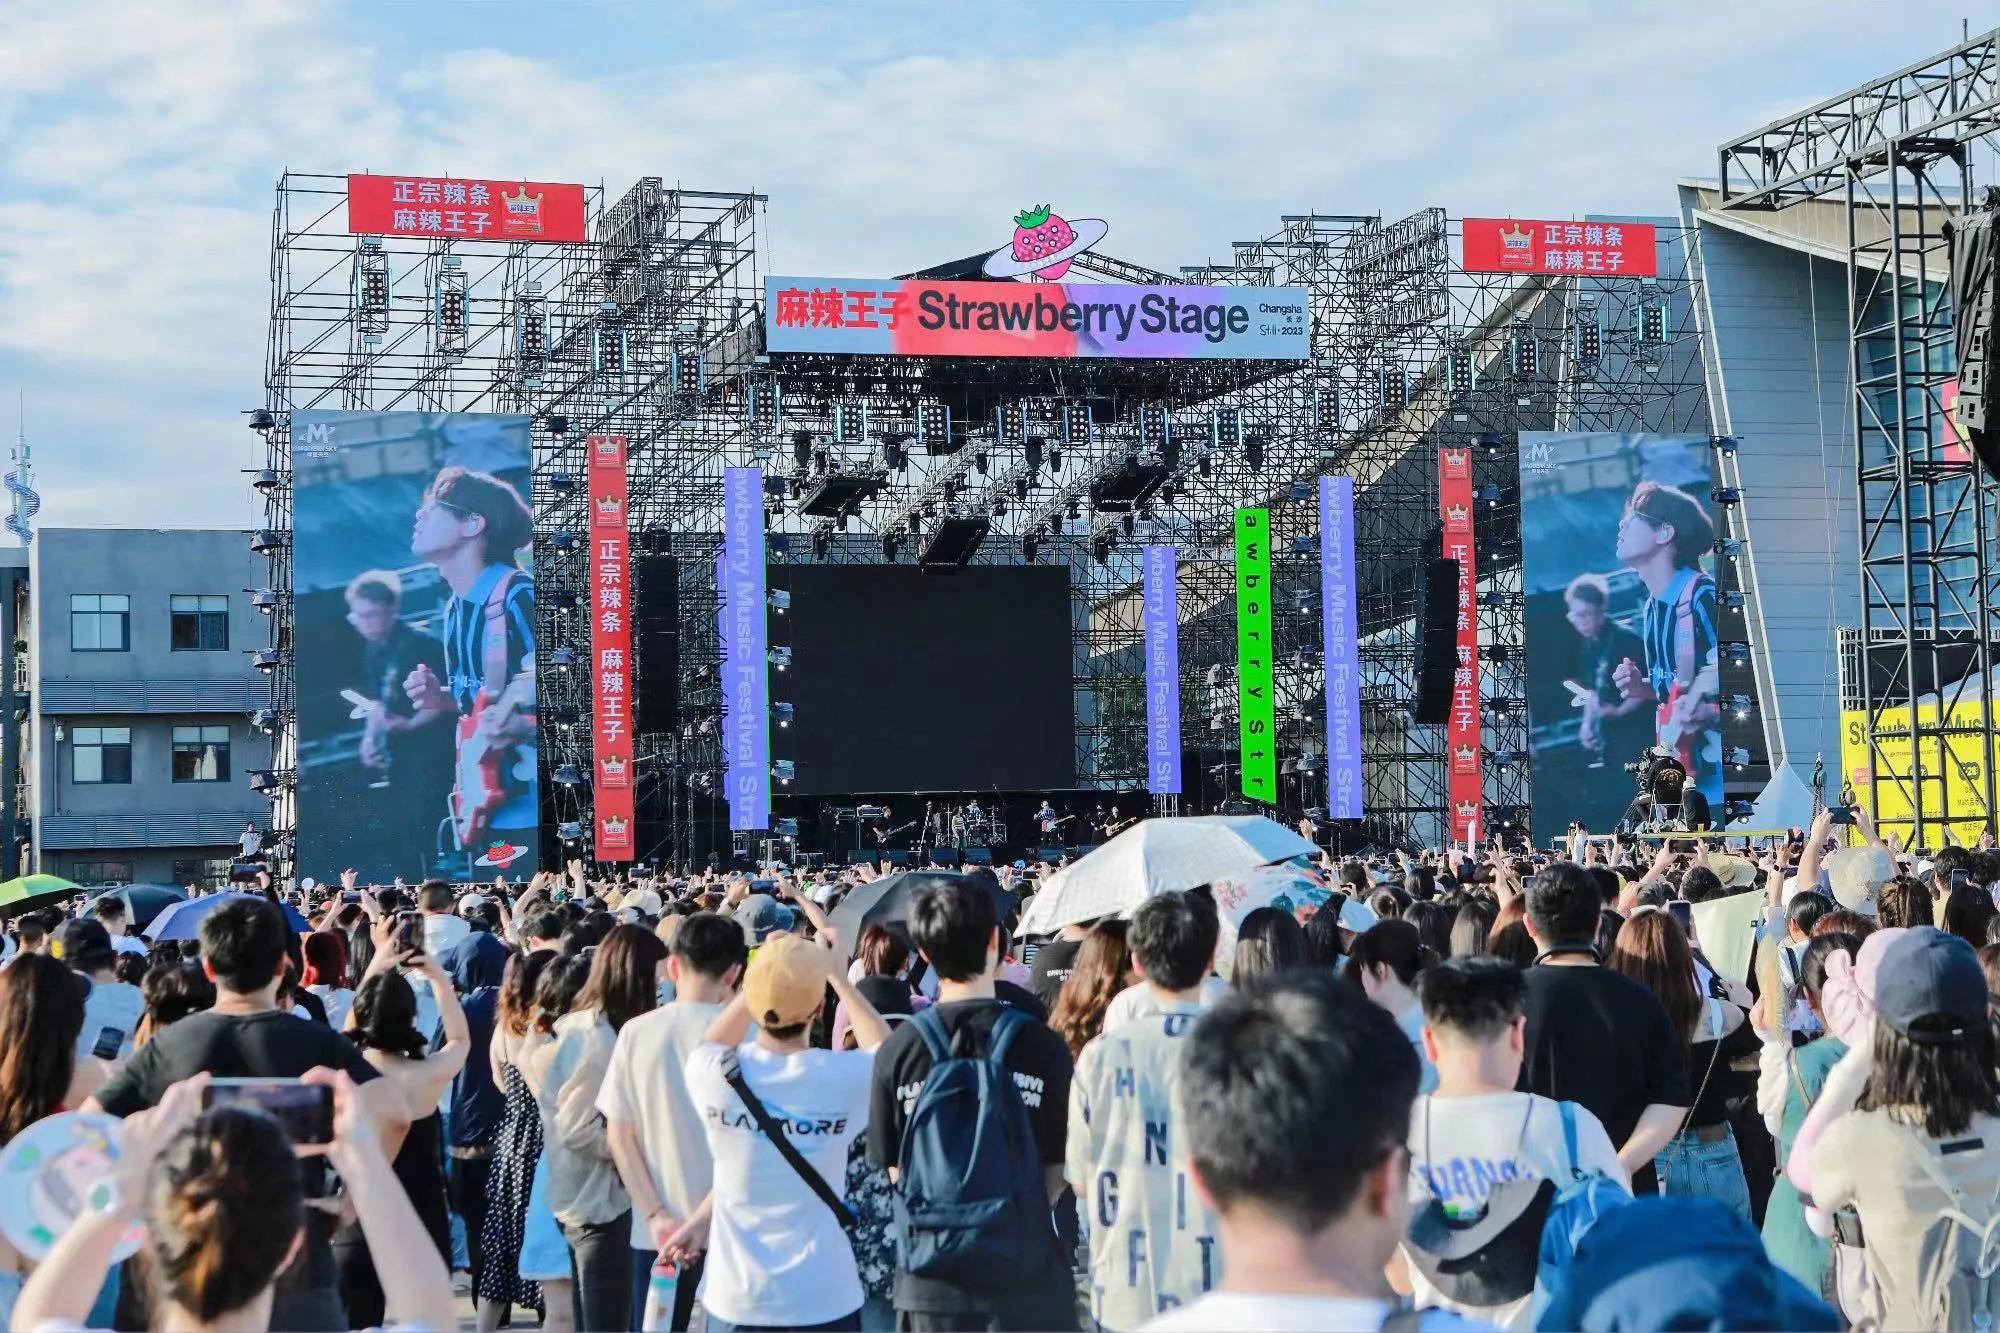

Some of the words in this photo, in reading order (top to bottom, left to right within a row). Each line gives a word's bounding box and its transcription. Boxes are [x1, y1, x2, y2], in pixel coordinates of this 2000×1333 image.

[393, 181, 491, 206] 正宗辣条
[393, 209, 492, 234] 麻辣王子
[1544, 225, 1624, 247] 正宗辣条
[1544, 250, 1625, 271] 麻辣王子
[776, 289, 909, 329] 麻辣王子
[918, 290, 1135, 341] Strawberry
[1141, 294, 1249, 343] Stage
[1259, 303, 1302, 315] Changsha
[599, 539, 622, 633] 正宗辣条
[736, 582, 755, 659] Music
[1331, 584, 1347, 657] Music
[1152, 622, 1169, 678] Music
[601, 648, 624, 742] 麻辣王子
[737, 665, 758, 767] Festival
[1155, 682, 1171, 756] Festival
[1333, 664, 1352, 760] Festival
[707, 1106, 848, 1135] PLAMORE
